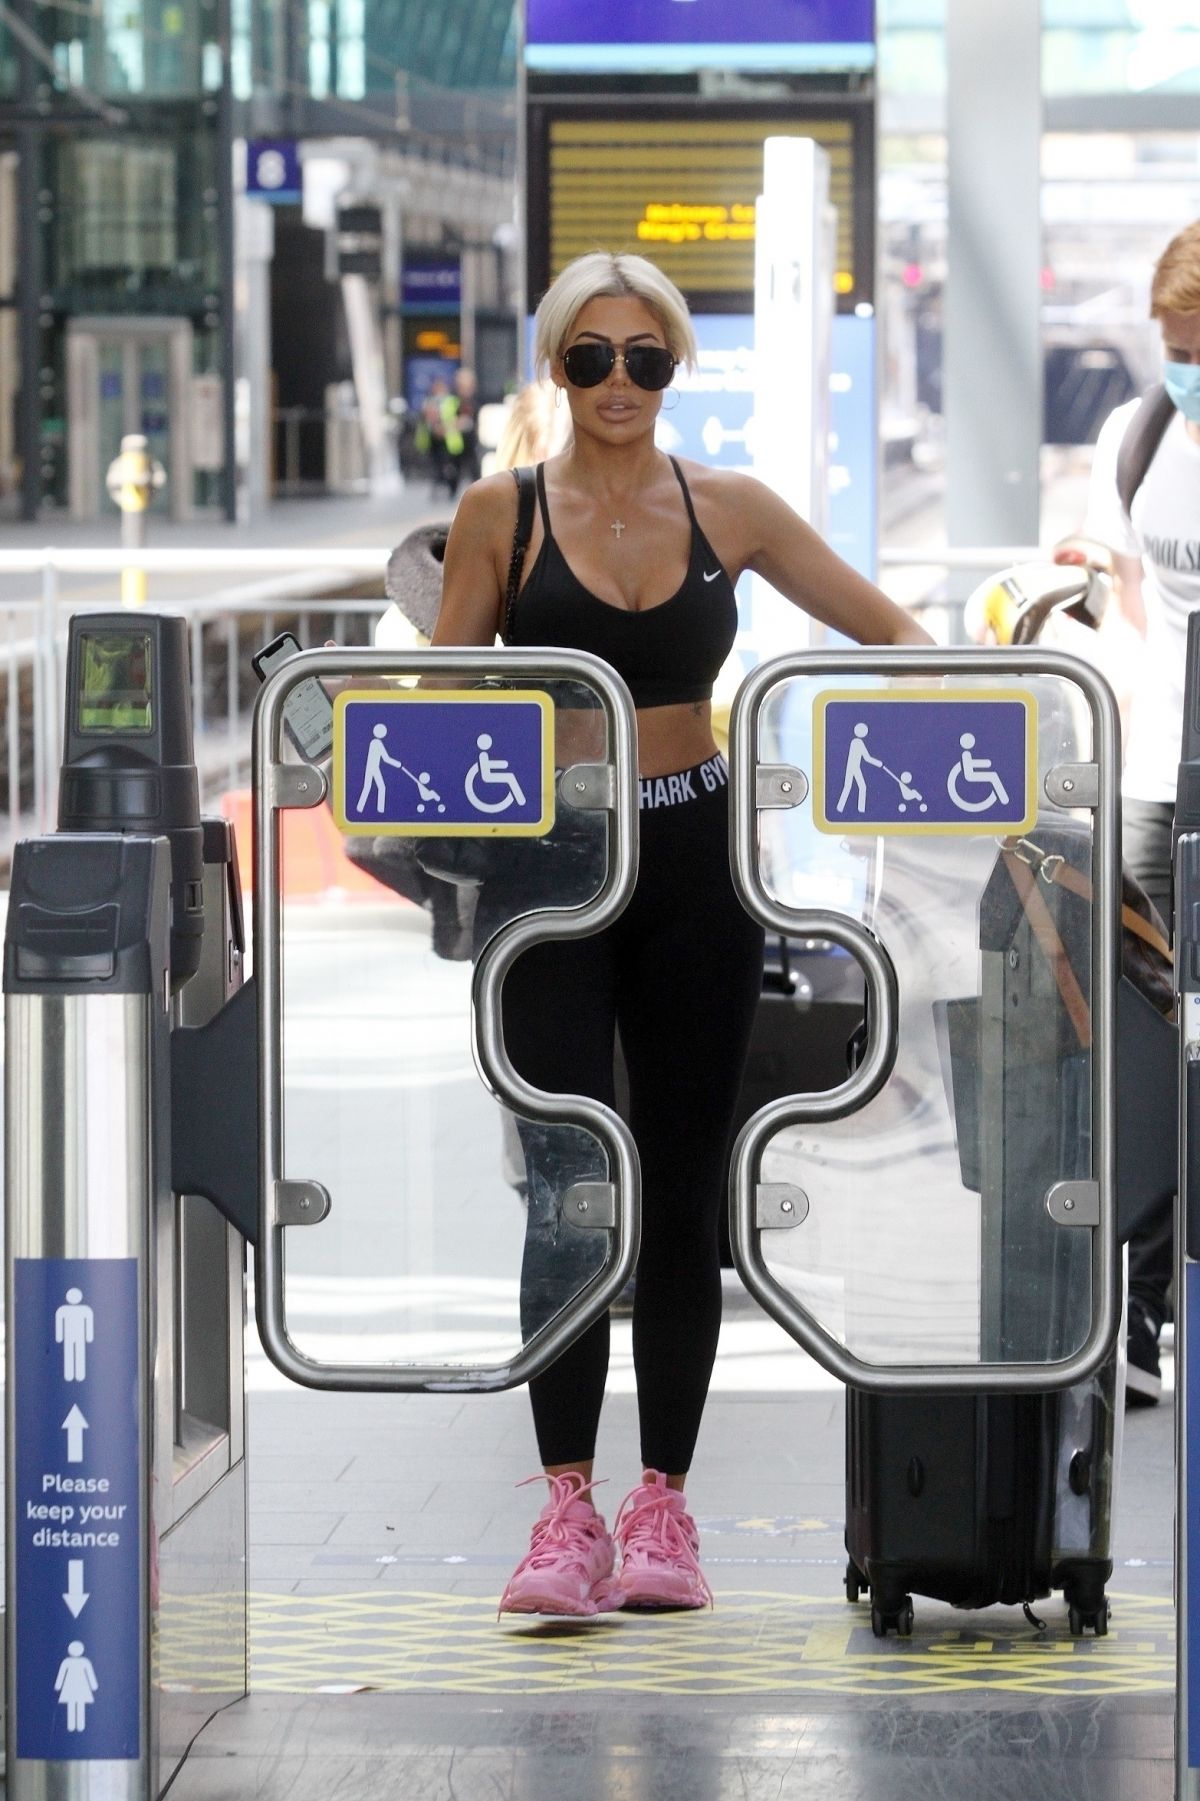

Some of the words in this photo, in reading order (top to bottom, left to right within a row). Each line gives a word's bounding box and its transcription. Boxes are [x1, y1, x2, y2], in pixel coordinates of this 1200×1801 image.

[639, 770, 698, 810] HARK
[42, 1474, 110, 1493] Please
[26, 1500, 75, 1525] keep
[79, 1504, 128, 1525] your
[32, 1527, 120, 1547] distance
